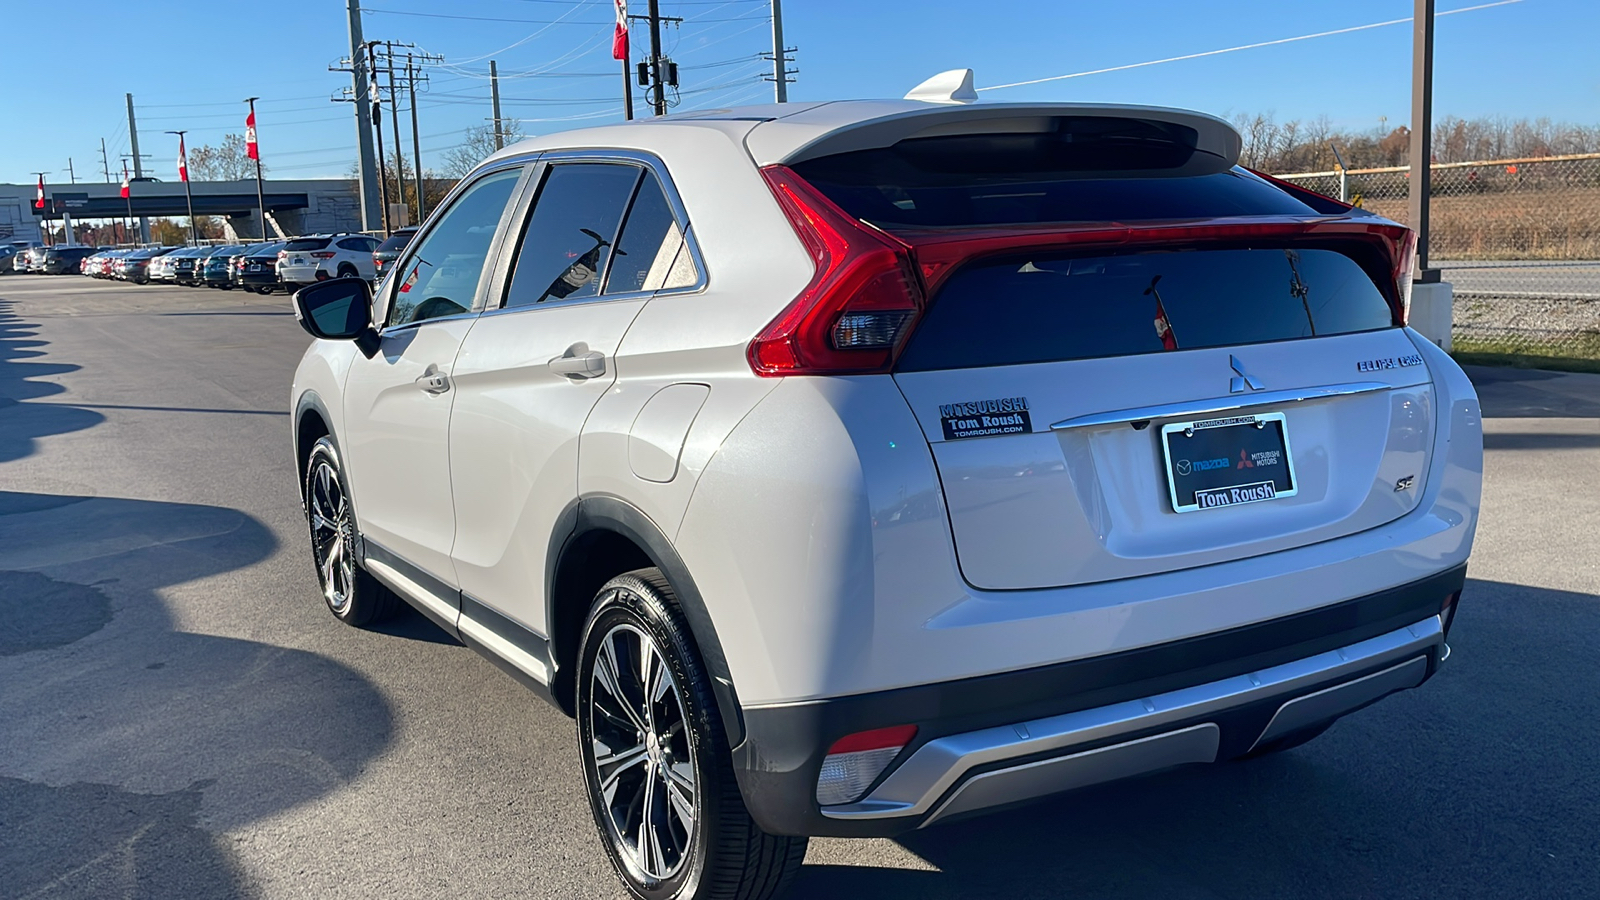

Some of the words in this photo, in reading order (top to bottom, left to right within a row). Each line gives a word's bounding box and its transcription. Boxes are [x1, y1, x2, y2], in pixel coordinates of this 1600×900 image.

[939, 397, 1029, 418] MITSUBISHI
[948, 418, 980, 430] Tom
[981, 413, 1024, 427] Roush
[954, 427, 1023, 437] TOMROUSH.COM
[1251, 450, 1280, 460] MITSUBISHI
[1256, 457, 1279, 467] MOTORS
[1197, 492, 1231, 508] Tom
[1230, 483, 1275, 503] Roush
